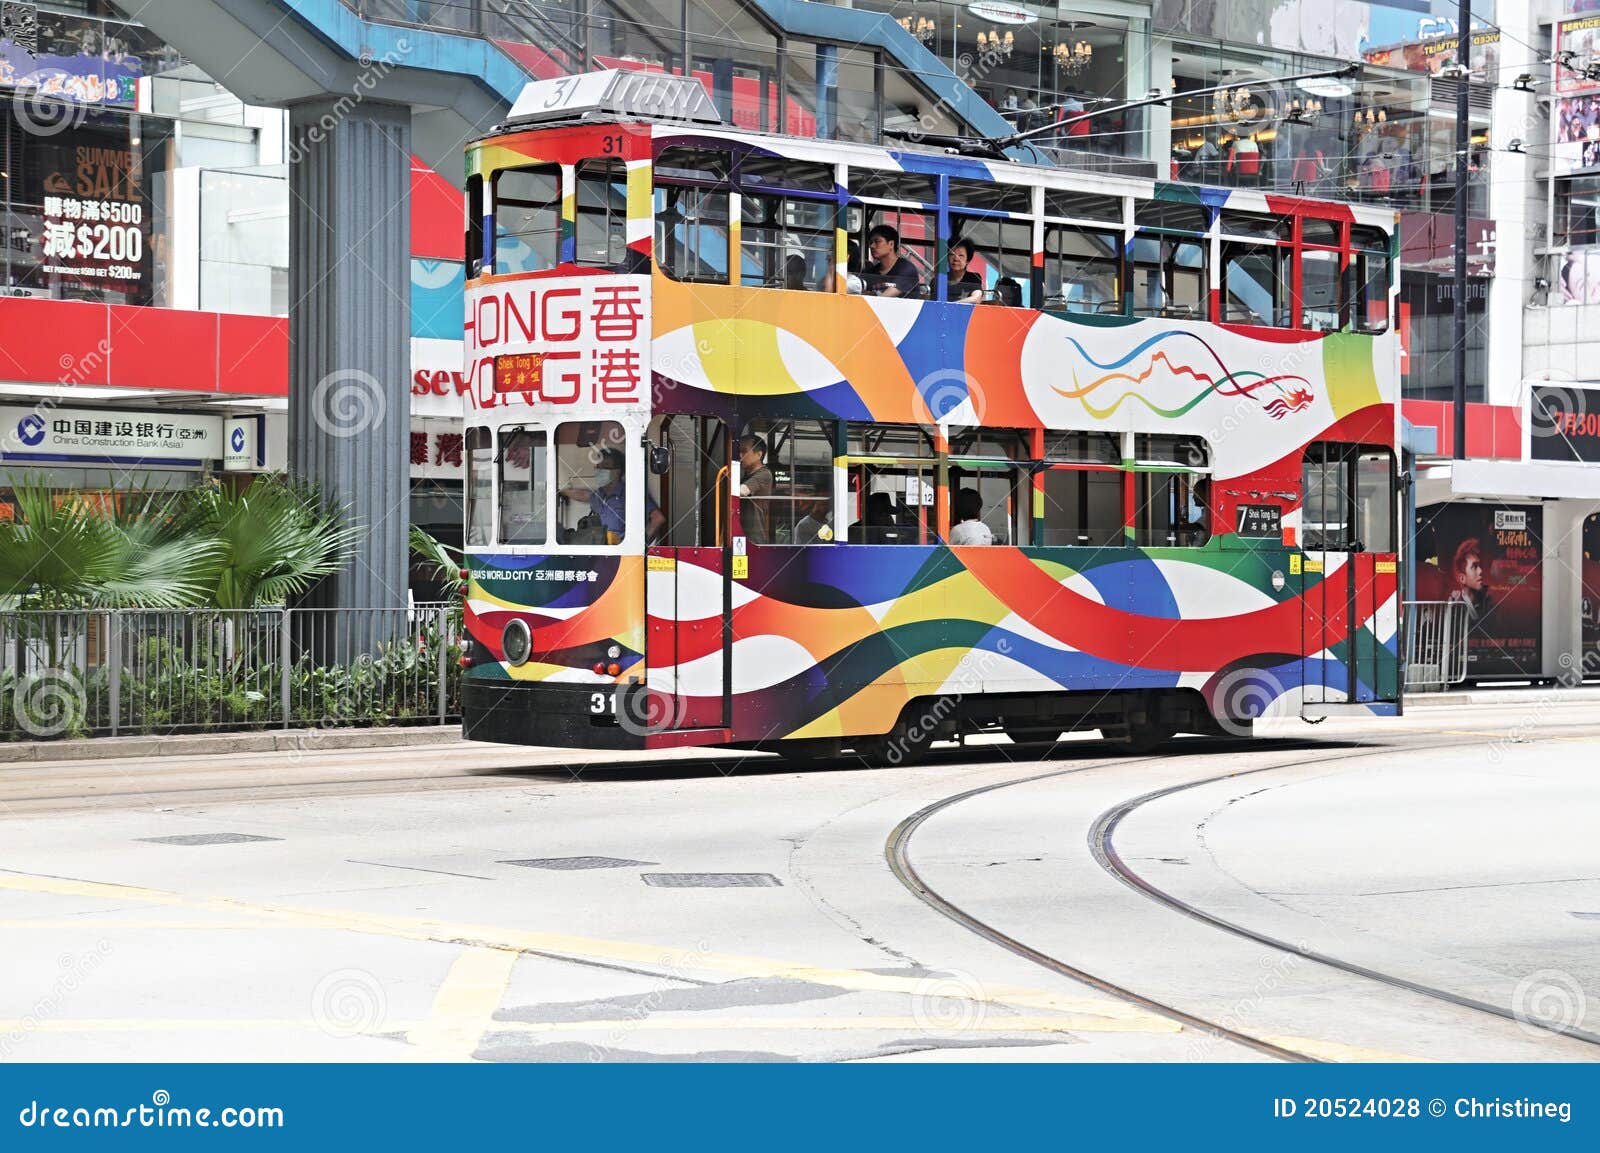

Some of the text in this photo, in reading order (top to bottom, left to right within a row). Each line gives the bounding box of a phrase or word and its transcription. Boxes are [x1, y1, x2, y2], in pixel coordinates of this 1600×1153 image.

[544, 77, 581, 109] 31
[602, 135, 624, 154] 31
[77, 163, 142, 202] SALE
[590, 286, 644, 342] 香
[464, 351, 581, 410] KOG
[591, 348, 641, 404] 港
[1553, 411, 1600, 438] 7月30
[53, 436, 79, 445] China
[81, 437, 135, 447] Construction
[137, 438, 158, 448] Bank
[1237, 506, 1248, 533] 7
[487, 570, 512, 581] WORLD
[512, 570, 533, 581] CITY
[590, 693, 617, 714] 31
